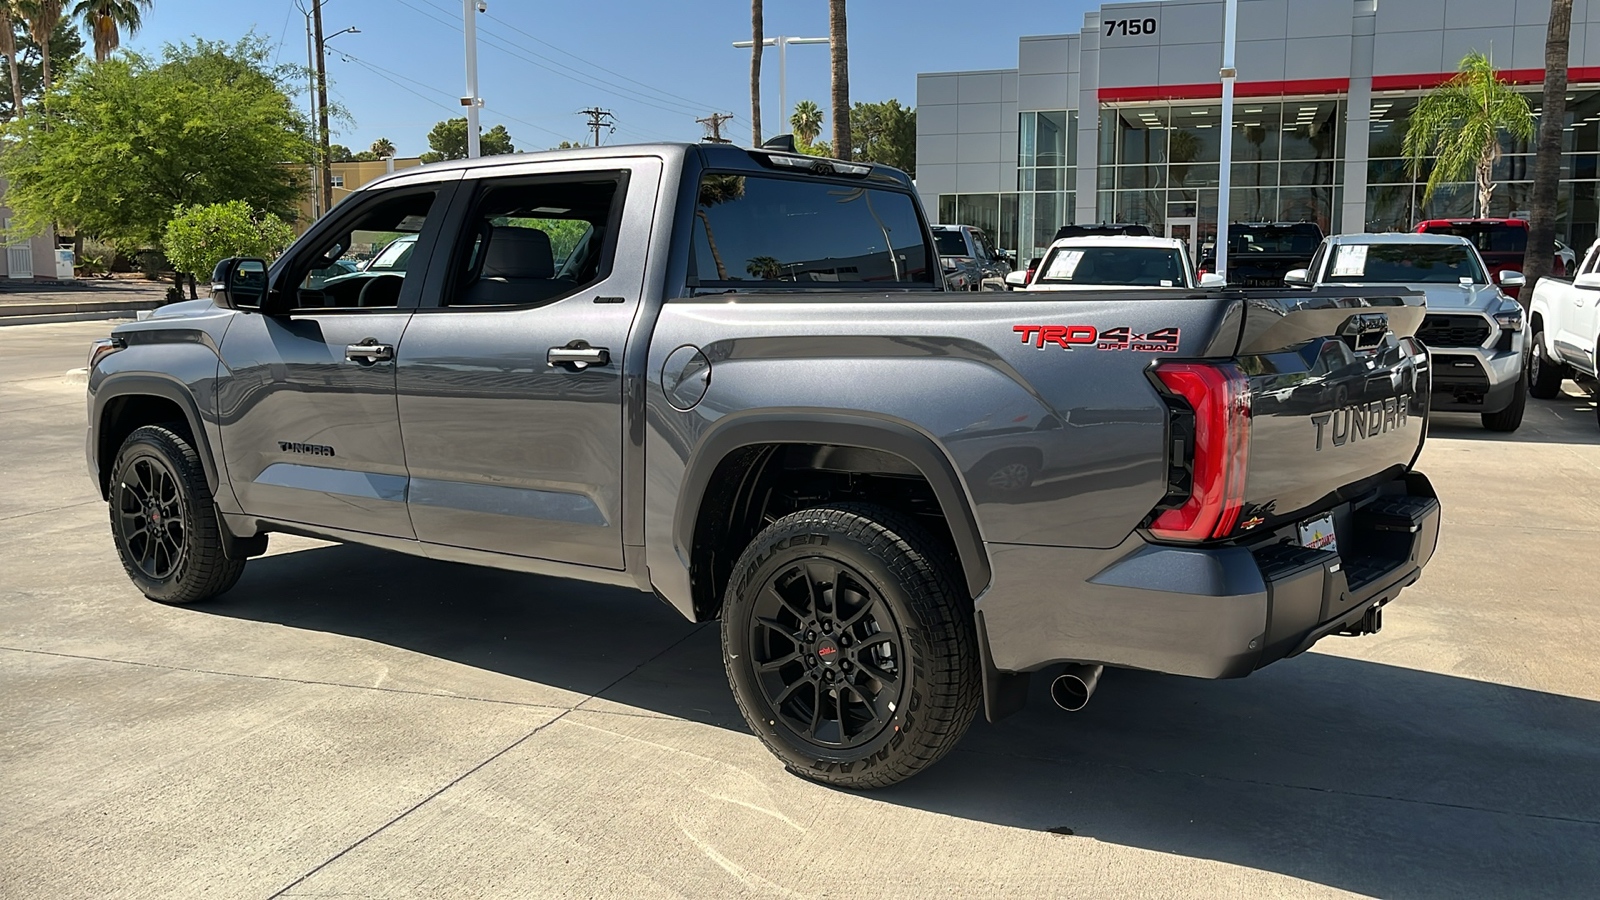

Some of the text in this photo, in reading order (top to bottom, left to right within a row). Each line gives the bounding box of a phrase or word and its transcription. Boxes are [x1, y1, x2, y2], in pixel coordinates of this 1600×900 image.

[1104, 18, 1156, 36] 7150
[1013, 325, 1098, 350] TRD
[1097, 343, 1178, 352] OFF ROAD
[1311, 393, 1409, 452] TUNDRA
[278, 441, 335, 457] TUNDRA
[735, 532, 830, 602] FALKEN
[861, 625, 925, 771] WILDPEAK
